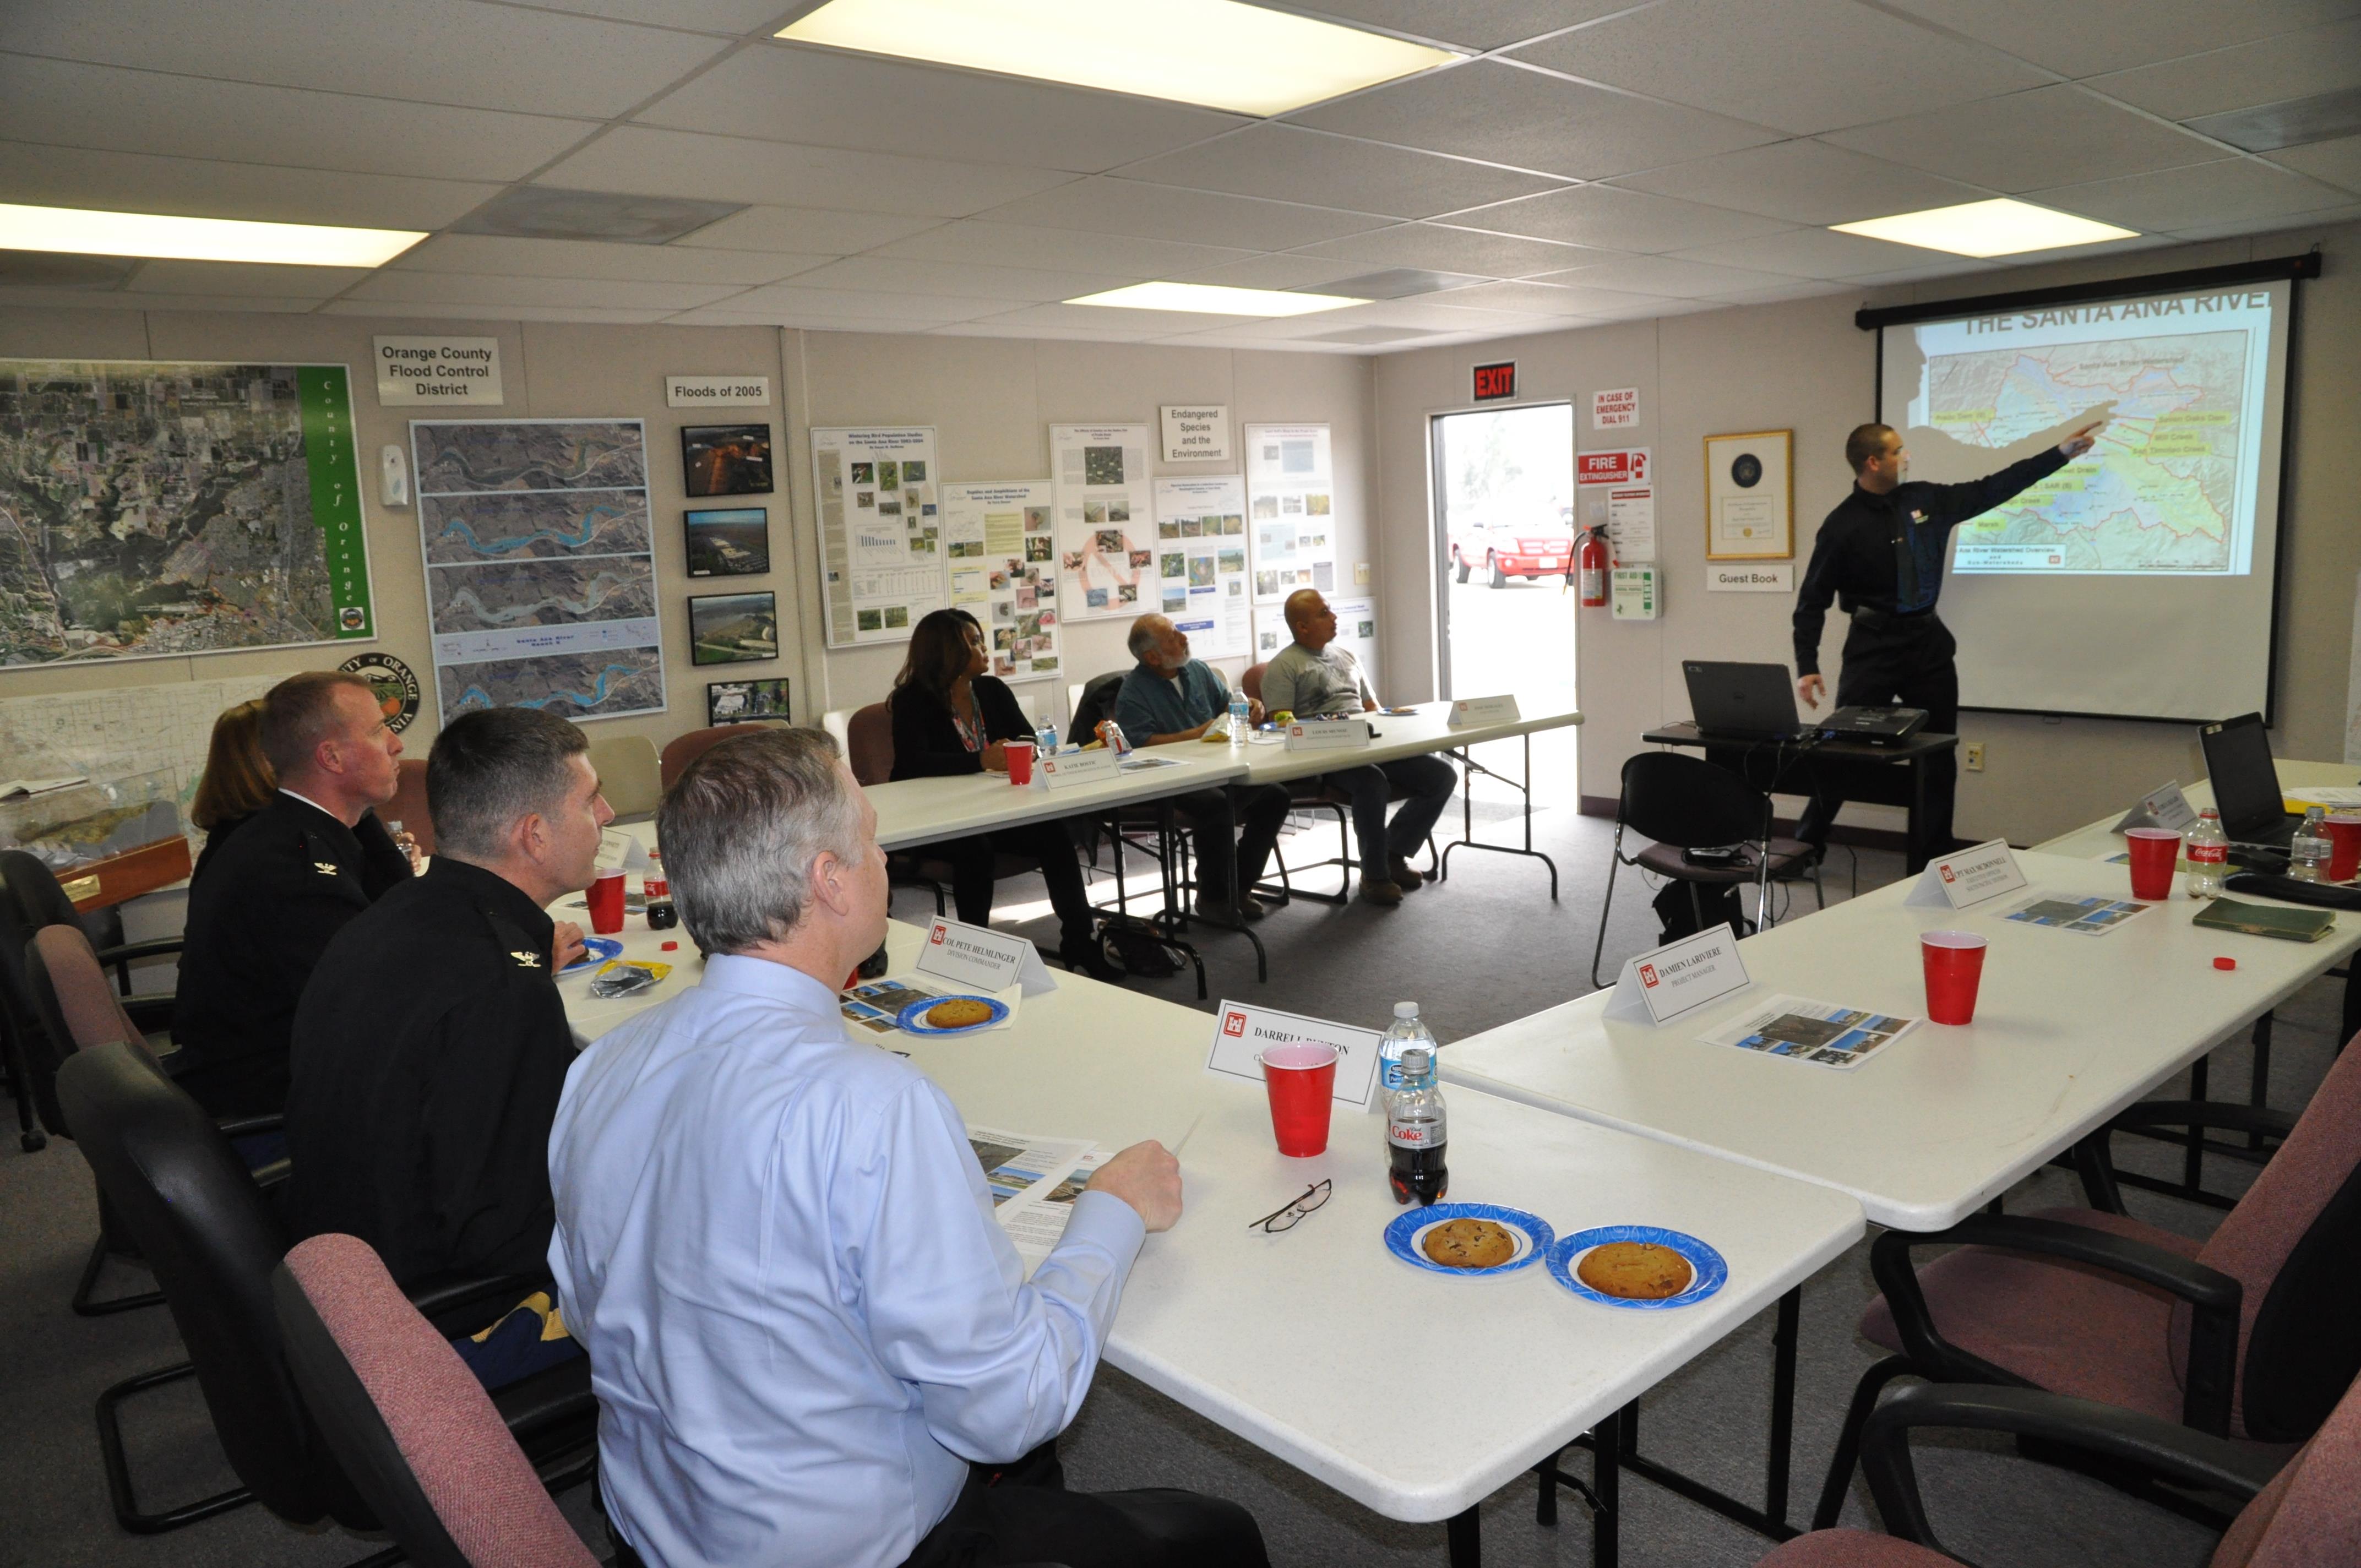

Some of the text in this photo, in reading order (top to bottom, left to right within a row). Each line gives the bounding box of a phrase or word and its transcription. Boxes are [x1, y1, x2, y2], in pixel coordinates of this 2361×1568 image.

[1966, 317, 2012, 335] THE
[2022, 306, 2114, 329] SANTA
[2194, 292, 2271, 313] RIVE
[382, 346, 492, 362] Orange County
[389, 365, 489, 378] Flood Control
[1475, 366, 1513, 396] EXIT
[416, 383, 468, 395] District
[674, 385, 762, 397] Floods of 2005
[1598, 392, 1633, 403] IN CASE OF
[1596, 403, 1636, 414] EMERGENCY
[1171, 410, 1218, 420] Endangered
[1602, 415, 1630, 424] DIAL 911
[1180, 423, 1211, 432] Species
[1182, 436, 1196, 444] and
[1172, 449, 1222, 458] Environment
[1588, 456, 1617, 470] FIRE
[1579, 471, 1628, 481] EXTINGUISHER
[1719, 574, 1778, 584] Guest Book
[383, 656, 418, 700] ORANGE
[942, 937, 1016, 964] COL PETE HELMLINGER
[947, 949, 1002, 970] DIVISION COMMANDER
[1659, 946, 1722, 978] DAMIEN LARIVIERE
[1671, 964, 1717, 988] PROJECT MANAGER
[1392, 1125, 1423, 1141] Coke
